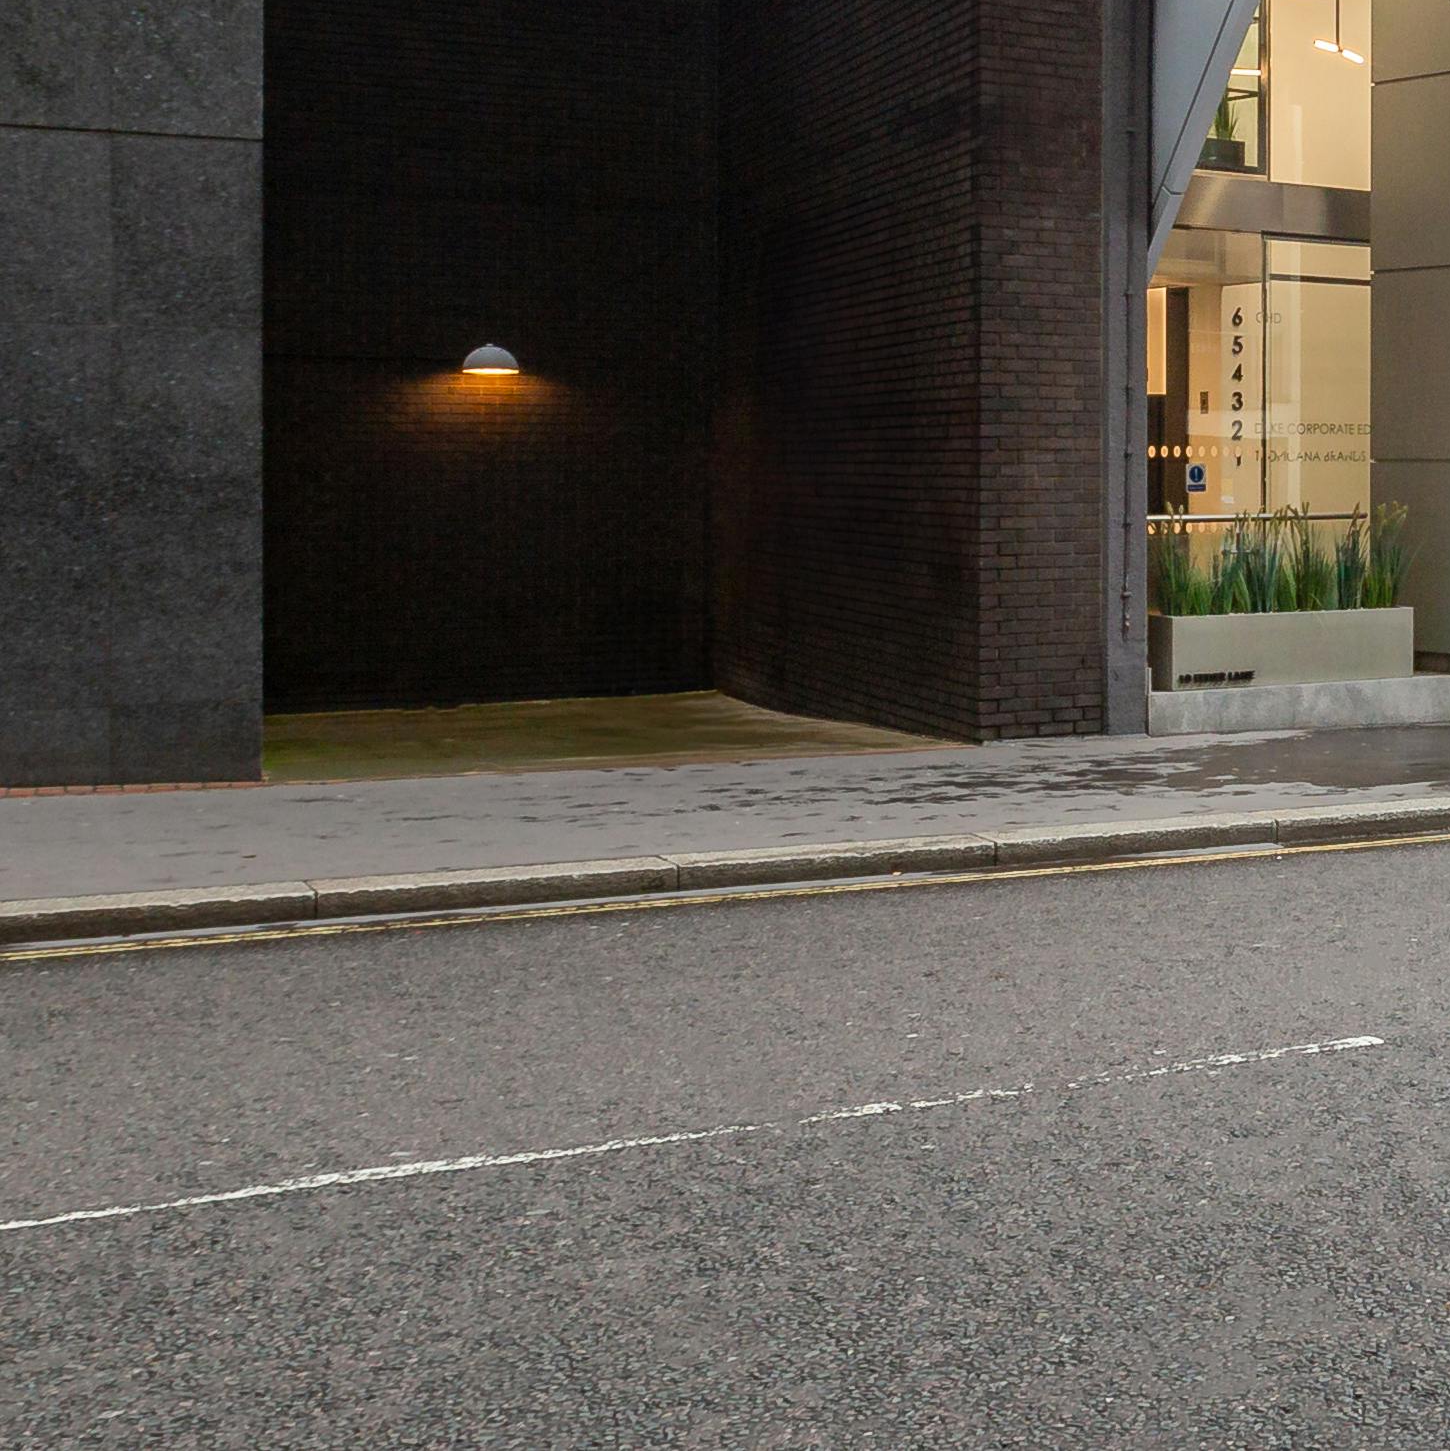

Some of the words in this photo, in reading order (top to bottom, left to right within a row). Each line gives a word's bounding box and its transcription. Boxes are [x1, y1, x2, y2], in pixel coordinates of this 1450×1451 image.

[1231, 307, 1243, 327] 6
[1231, 335, 1244, 355] 5
[1231, 363, 1244, 382] 4
[1231, 392, 1244, 411] 3
[1231, 420, 1243, 441] 2
[1287, 423, 1355, 435] CORPORATE
